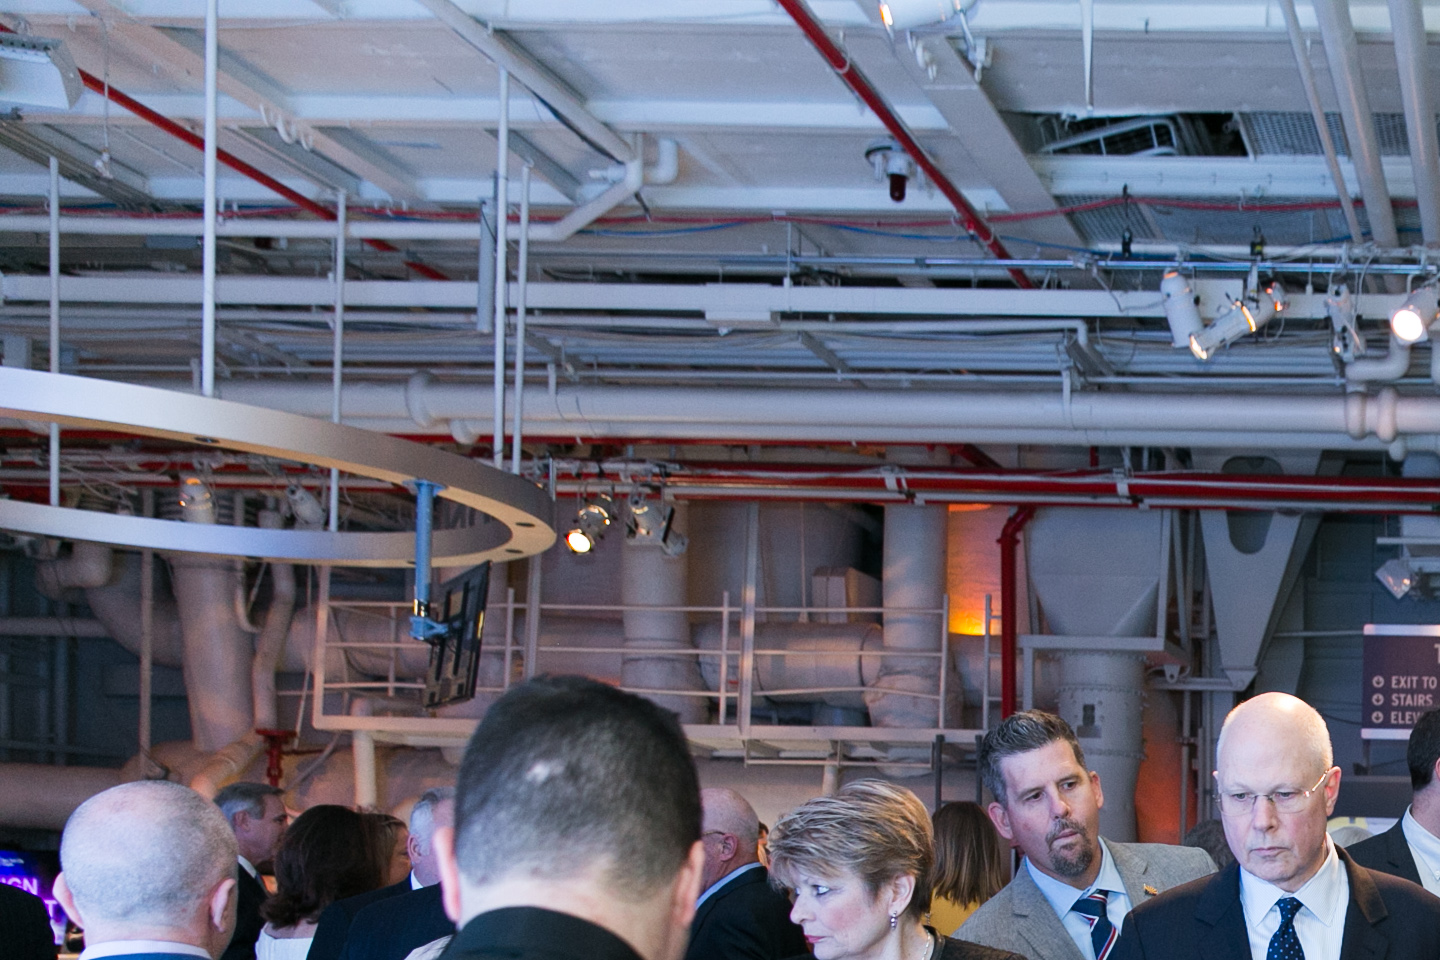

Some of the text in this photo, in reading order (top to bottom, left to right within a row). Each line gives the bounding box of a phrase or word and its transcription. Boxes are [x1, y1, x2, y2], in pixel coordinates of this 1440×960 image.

[1391, 675, 1418, 690] EXIT
[1421, 676, 1438, 690] TO
[1391, 693, 1433, 707] STAIRS
